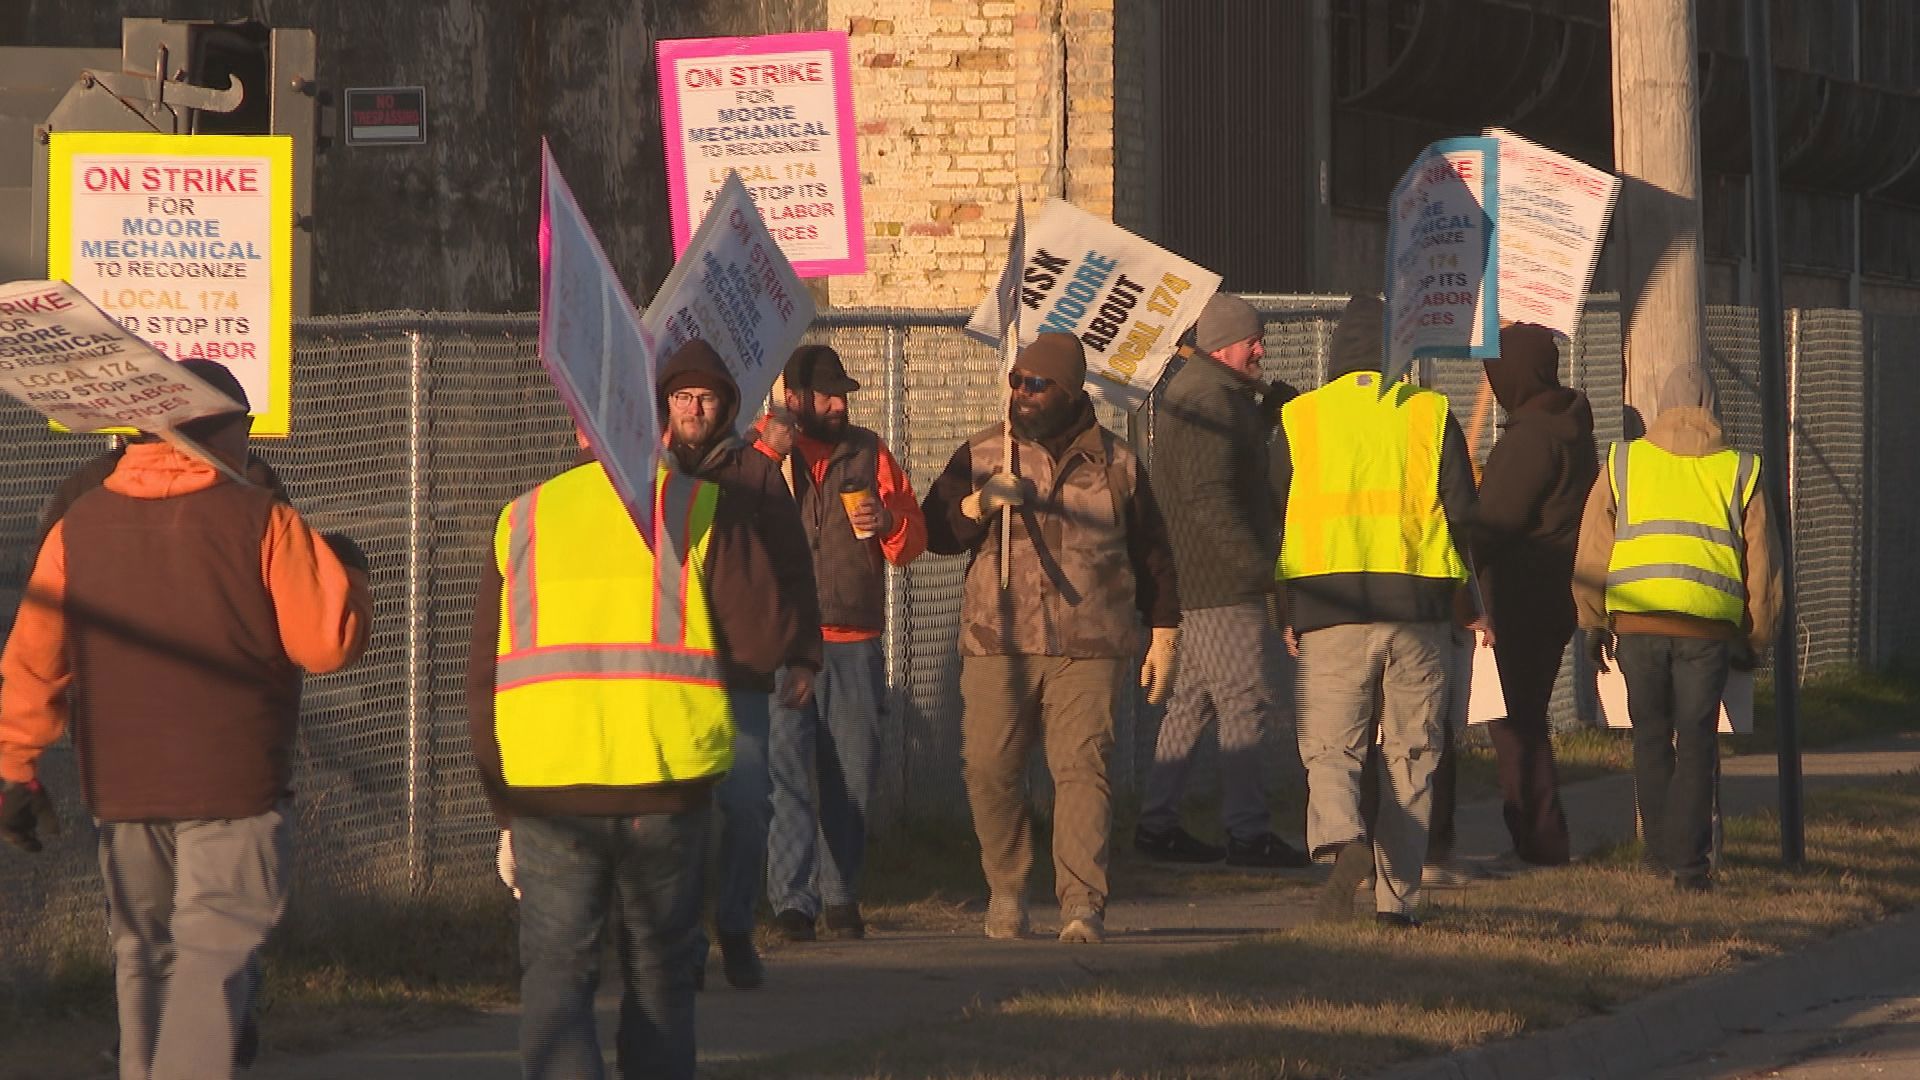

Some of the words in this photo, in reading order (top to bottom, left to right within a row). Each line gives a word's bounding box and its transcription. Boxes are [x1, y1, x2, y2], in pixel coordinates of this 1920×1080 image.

[685, 67, 723, 88] ON
[730, 62, 824, 87] STRIKE
[736, 89, 775, 104] FOR
[718, 105, 796, 123] MOORE
[688, 121, 831, 142] MECHANICAL
[700, 144, 723, 157] TO
[726, 139, 821, 156] RECOGNIZE
[84, 167, 131, 192] ON
[142, 167, 258, 192] STRIKE
[785, 162, 818, 180] 174
[800, 182, 829, 199] ITS
[148, 197, 195, 215] FOR
[771, 202, 835, 220] LABOR
[122, 218, 220, 238] MOORE
[730, 207, 752, 246] ON
[81, 240, 262, 260] MECHANICAL
[95, 262, 122, 278] TO
[128, 261, 247, 279] RECOGNIZE
[1022, 248, 1071, 310] ASK
[1440, 272, 1466, 287] ITS
[103, 288, 190, 310] LOCAL
[198, 290, 240, 311] 174
[1035, 250, 1119, 334] MOORE
[1080, 274, 1145, 353] ABOUT
[148, 316, 208, 334] STOP
[215, 316, 250, 335] ITS
[1101, 320, 1165, 385] LOCAL
[1146, 271, 1193, 317] 174
[175, 341, 256, 360] LABOR
[15, 367, 98, 389] LOCAL
[99, 360, 141, 378] 174
[72, 380, 128, 397] STOP
